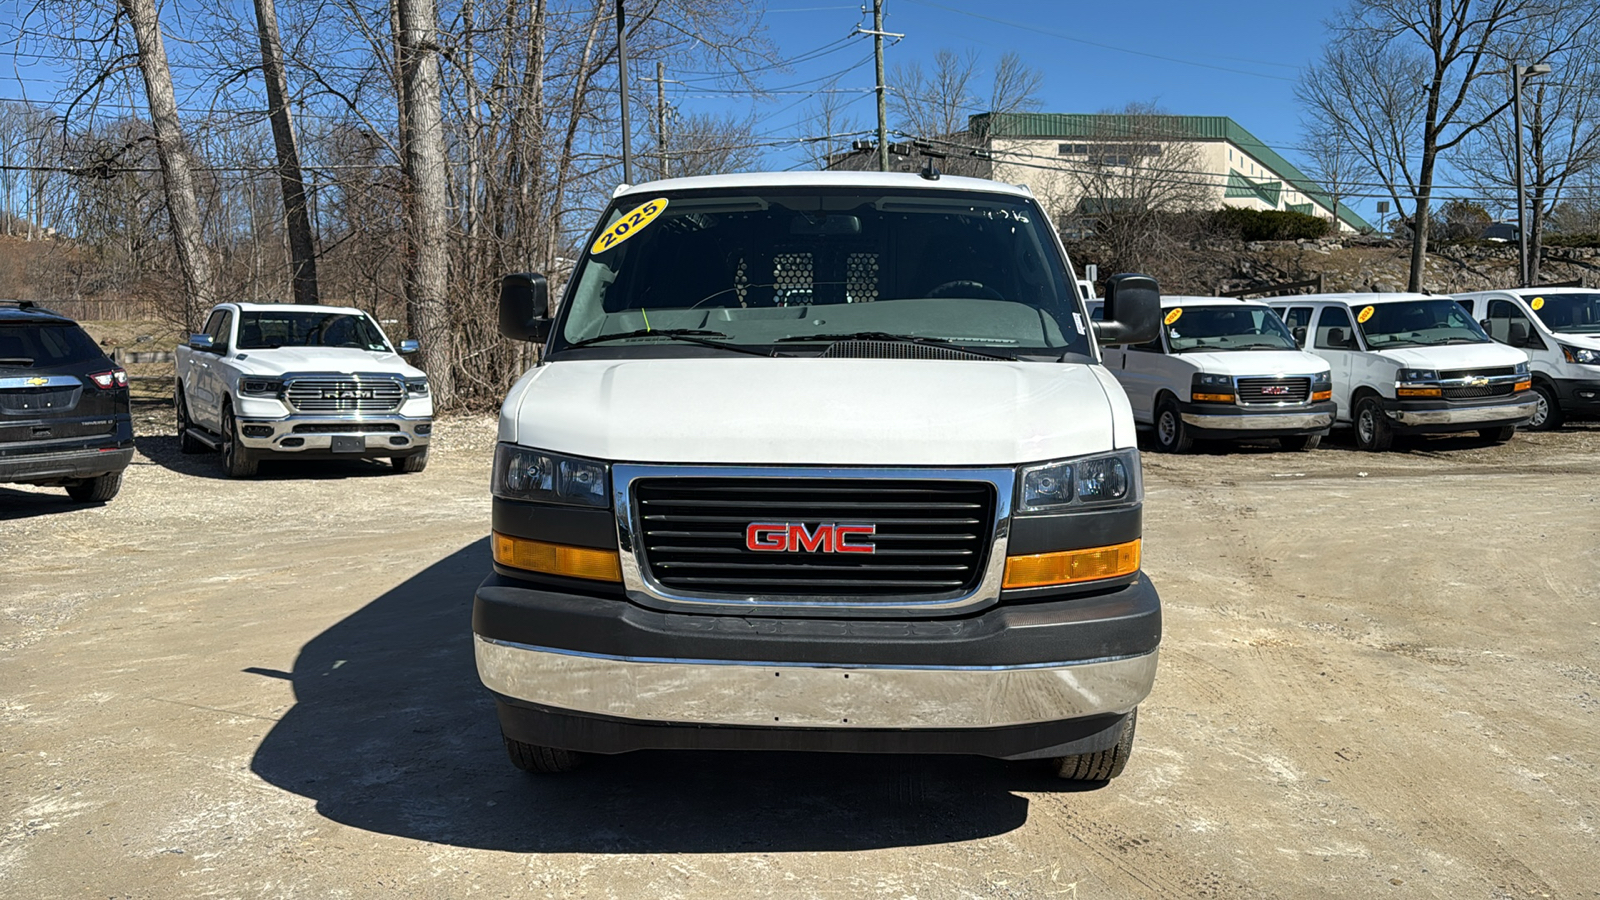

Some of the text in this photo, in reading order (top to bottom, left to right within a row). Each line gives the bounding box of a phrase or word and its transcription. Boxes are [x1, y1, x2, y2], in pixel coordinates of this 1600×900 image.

[600, 202, 658, 249] 2025
[324, 390, 372, 398] RAM
[746, 522, 876, 554] GMC
